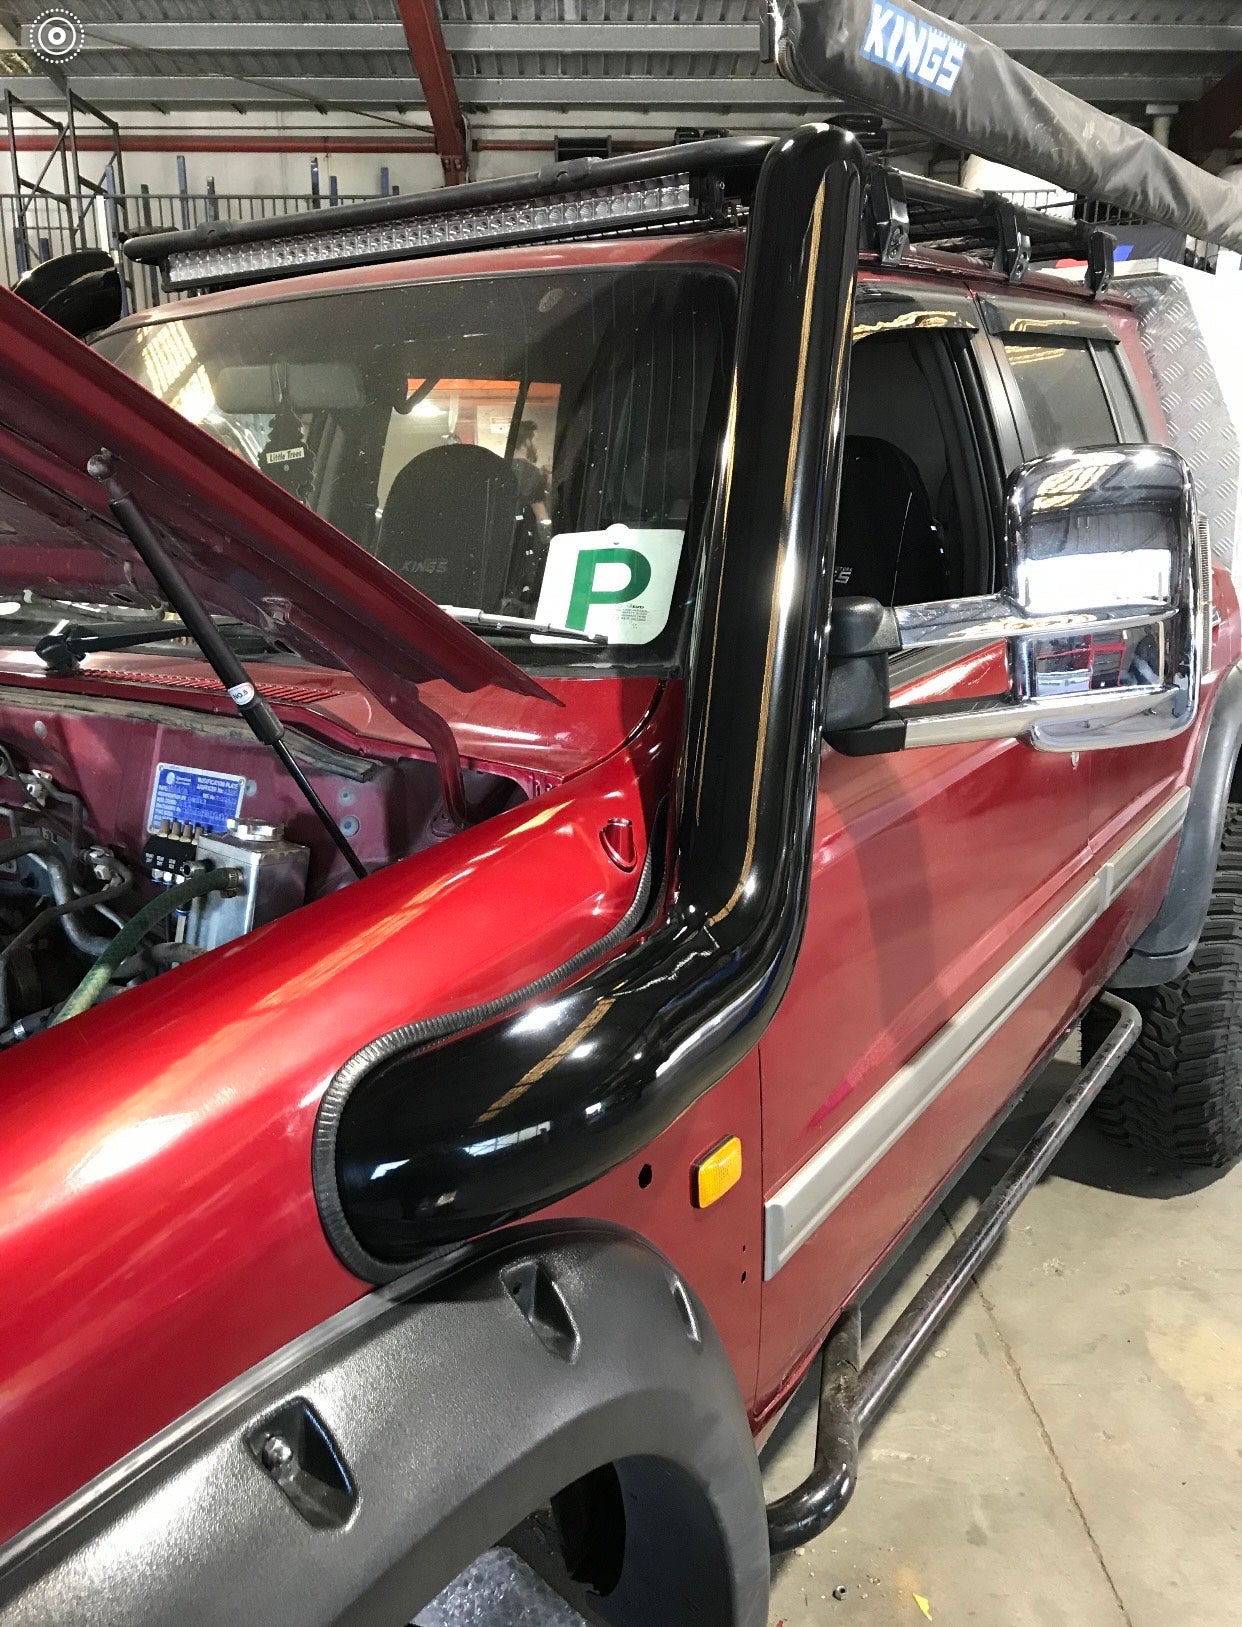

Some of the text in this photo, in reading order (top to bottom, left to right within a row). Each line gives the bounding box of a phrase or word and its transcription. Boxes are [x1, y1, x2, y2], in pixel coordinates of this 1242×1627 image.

[864, 3, 966, 91] KINGS
[270, 450, 302, 462] Little Trees
[401, 559, 448, 573] KINGS
[565, 548, 651, 632] P
